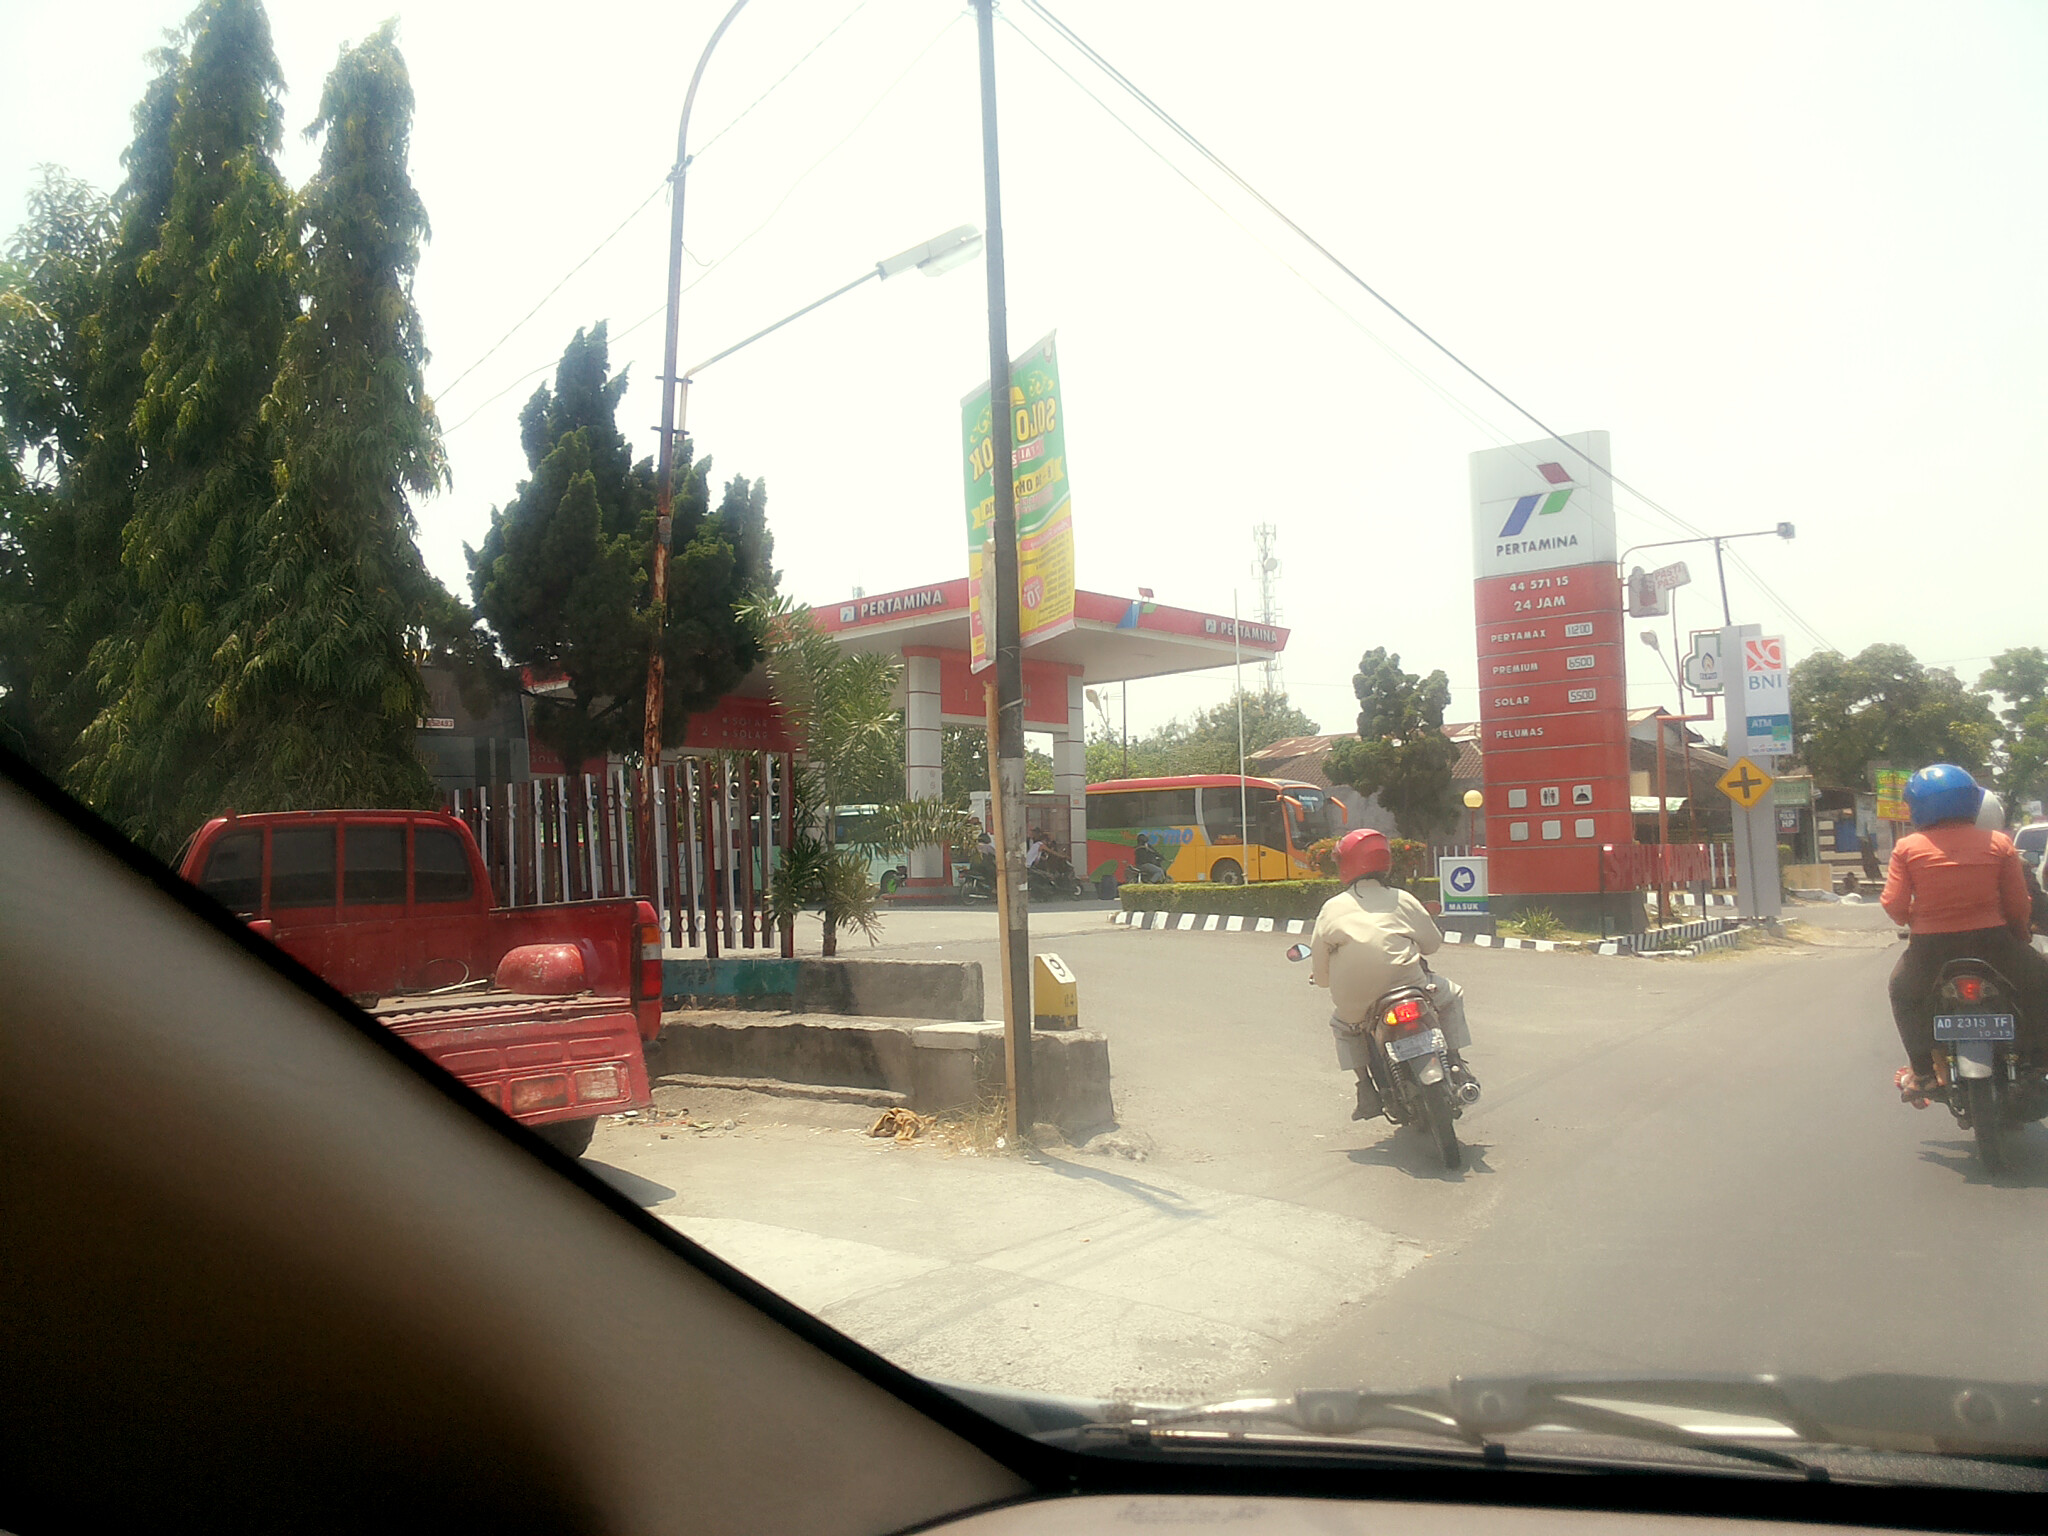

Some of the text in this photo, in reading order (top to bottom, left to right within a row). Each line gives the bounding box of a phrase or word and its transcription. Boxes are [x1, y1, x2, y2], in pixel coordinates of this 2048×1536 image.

[1496, 534, 1578, 557] PERTAMINA
[1509, 575, 1569, 593] 44 571 15
[861, 589, 942, 618] PERTAMINA
[1514, 595, 1566, 612] 24 JAM
[1490, 623, 1592, 643] PERTAMAX 11200
[1492, 656, 1593, 675] PREMIUM 6500
[1749, 674, 1782, 690] BNI
[1494, 689, 1595, 707] SOLAR 5500
[1751, 718, 1772, 729] ATM
[1495, 728, 1544, 739] PELUMAS
[1781, 820, 1795, 828] HP
[1448, 903, 1479, 911] MASUK
[1993, 1017, 2008, 1028] TF
